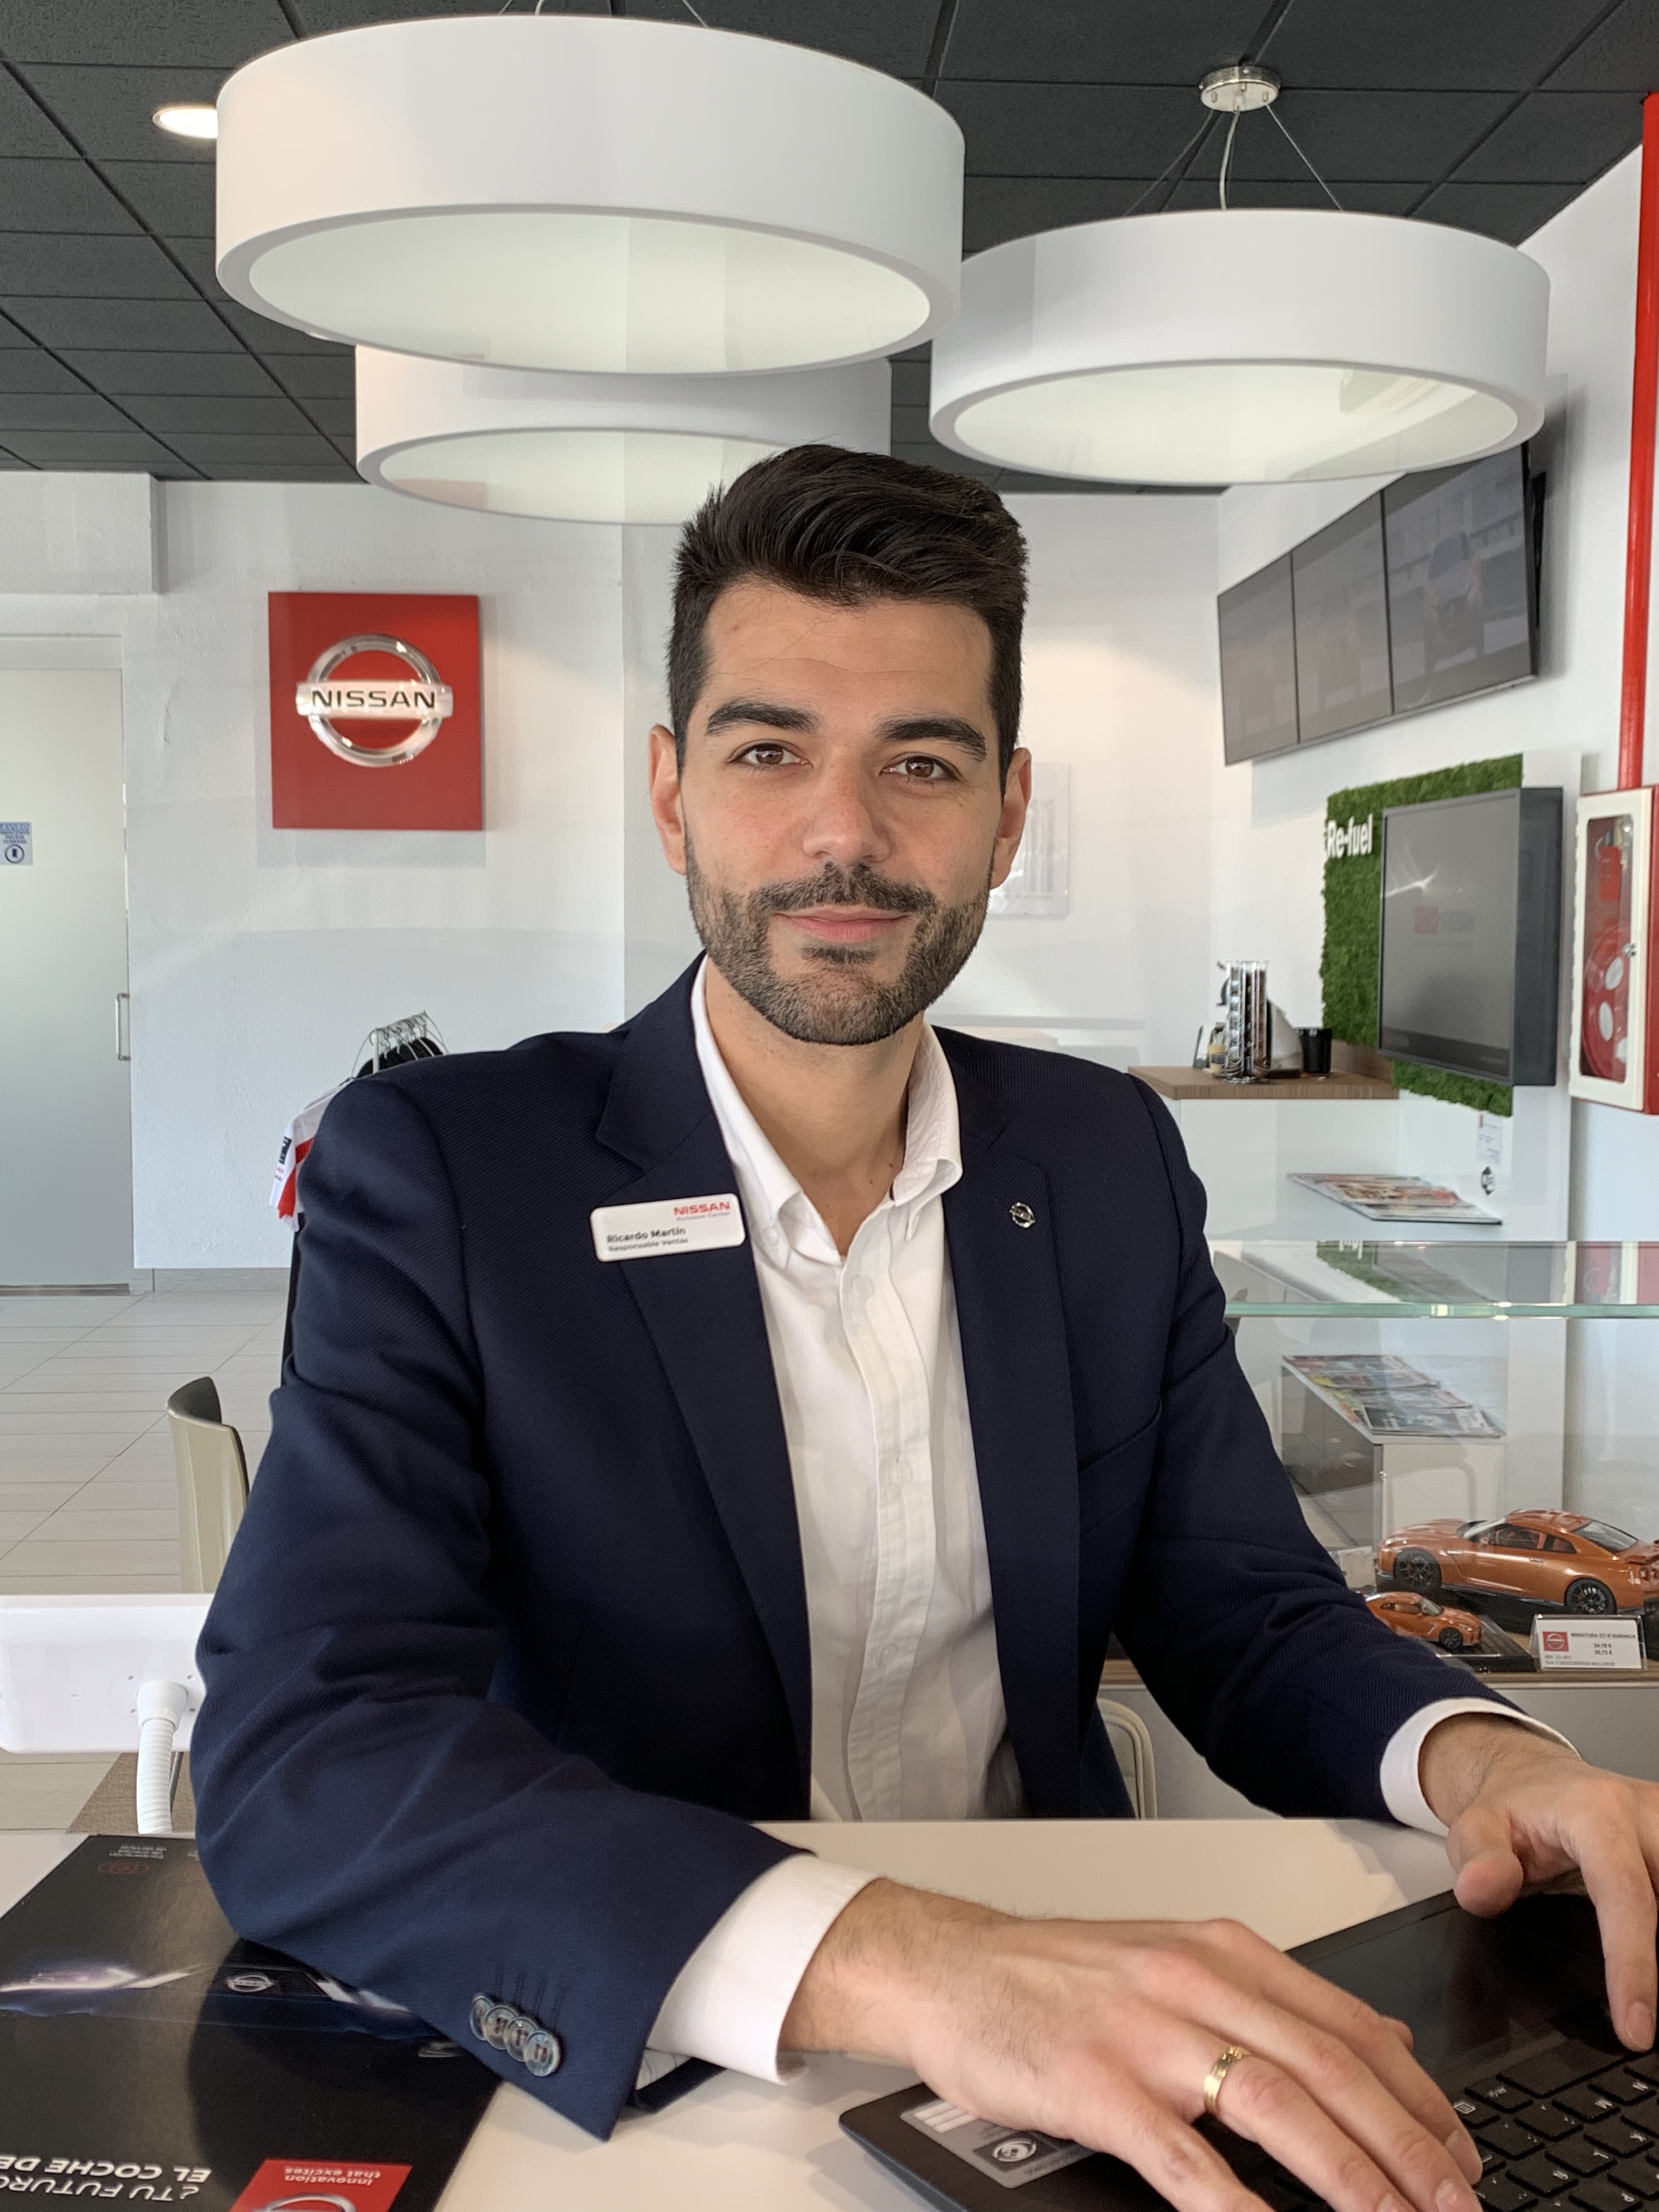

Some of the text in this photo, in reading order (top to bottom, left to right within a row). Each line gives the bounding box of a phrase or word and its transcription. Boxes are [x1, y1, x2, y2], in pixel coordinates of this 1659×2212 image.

[311, 690, 436, 709] NISSAN
[1327, 813, 1373, 858] Re-fuel
[674, 1201, 730, 1216] NISSAN
[607, 1231, 648, 1243] Ricardo
[44, 2156, 163, 2180] COCHE
[173, 2167, 212, 2183] EL
[284, 2167, 381, 2179] that excites
[284, 2174, 373, 2186] innovation
